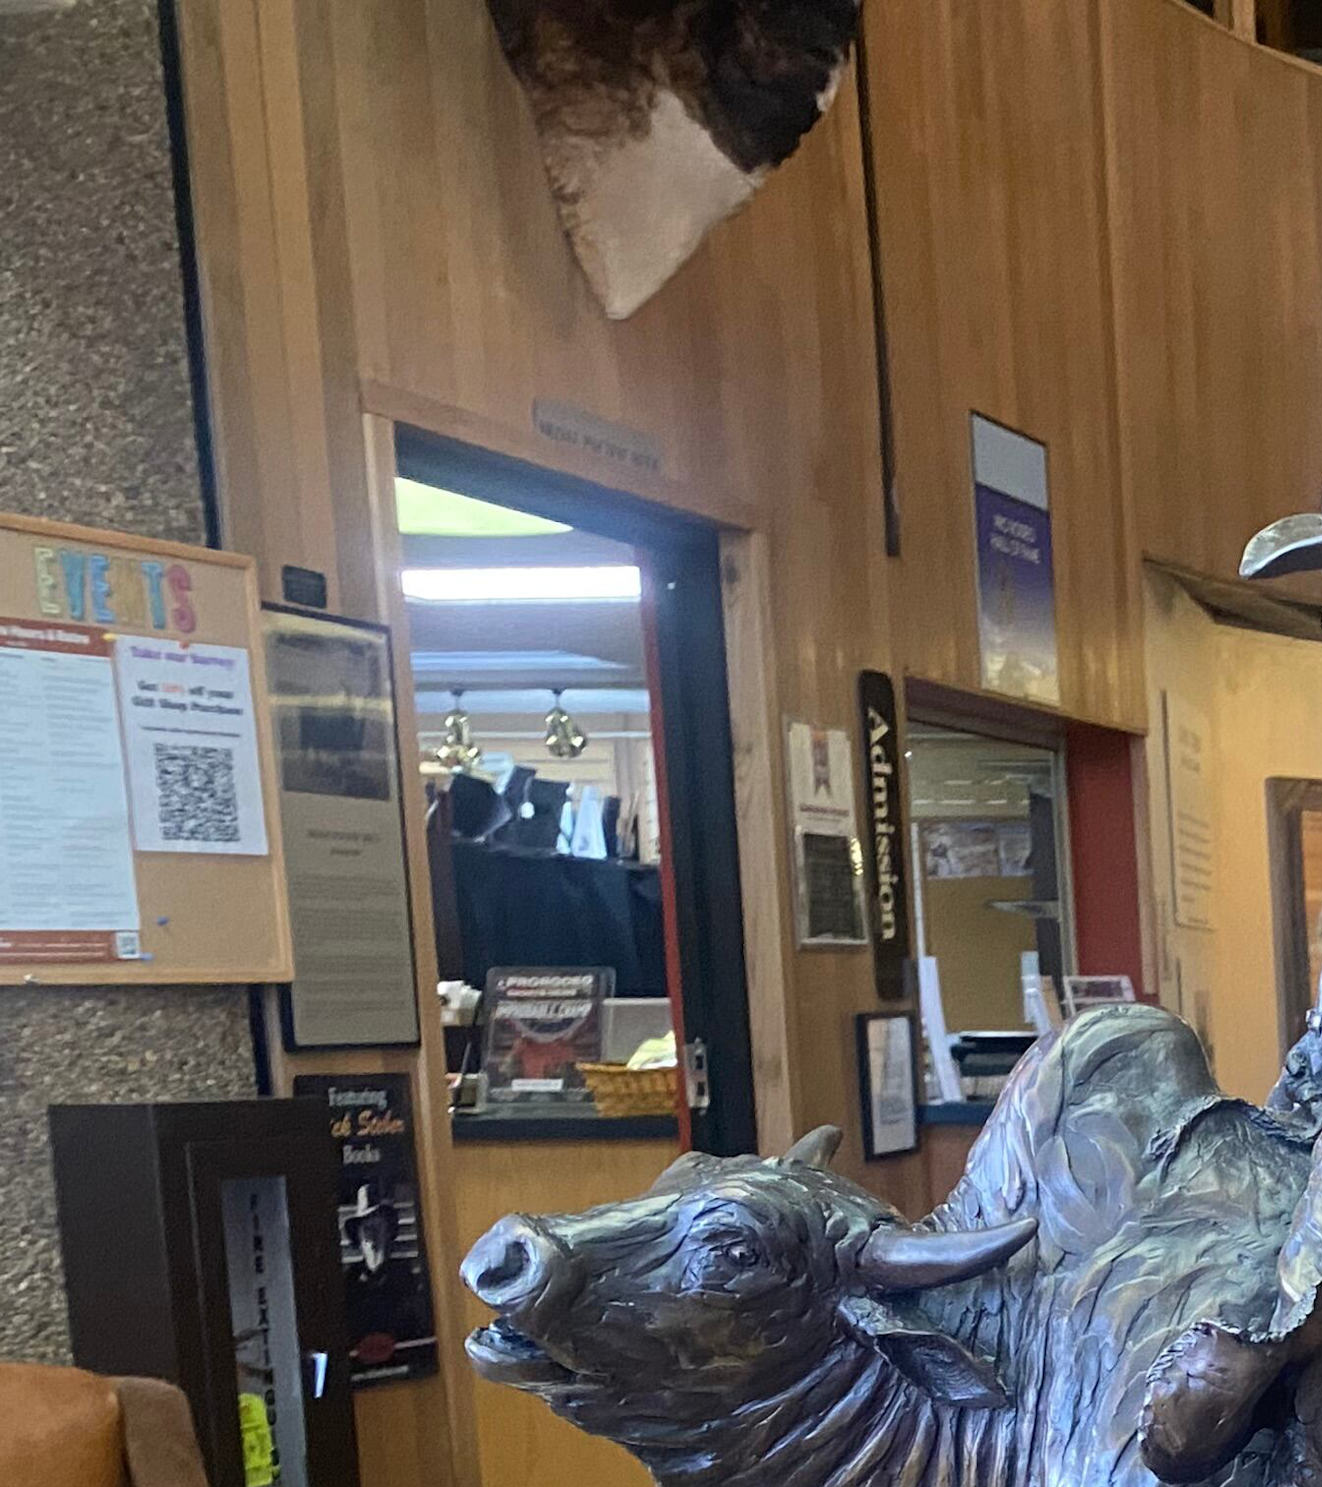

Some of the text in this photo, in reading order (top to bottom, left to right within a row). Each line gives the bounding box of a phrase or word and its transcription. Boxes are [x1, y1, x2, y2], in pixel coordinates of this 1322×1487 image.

[35, 547, 196, 634] EVENTS
[867, 706, 899, 940] Admission
[343, 1144, 380, 1165] Books
